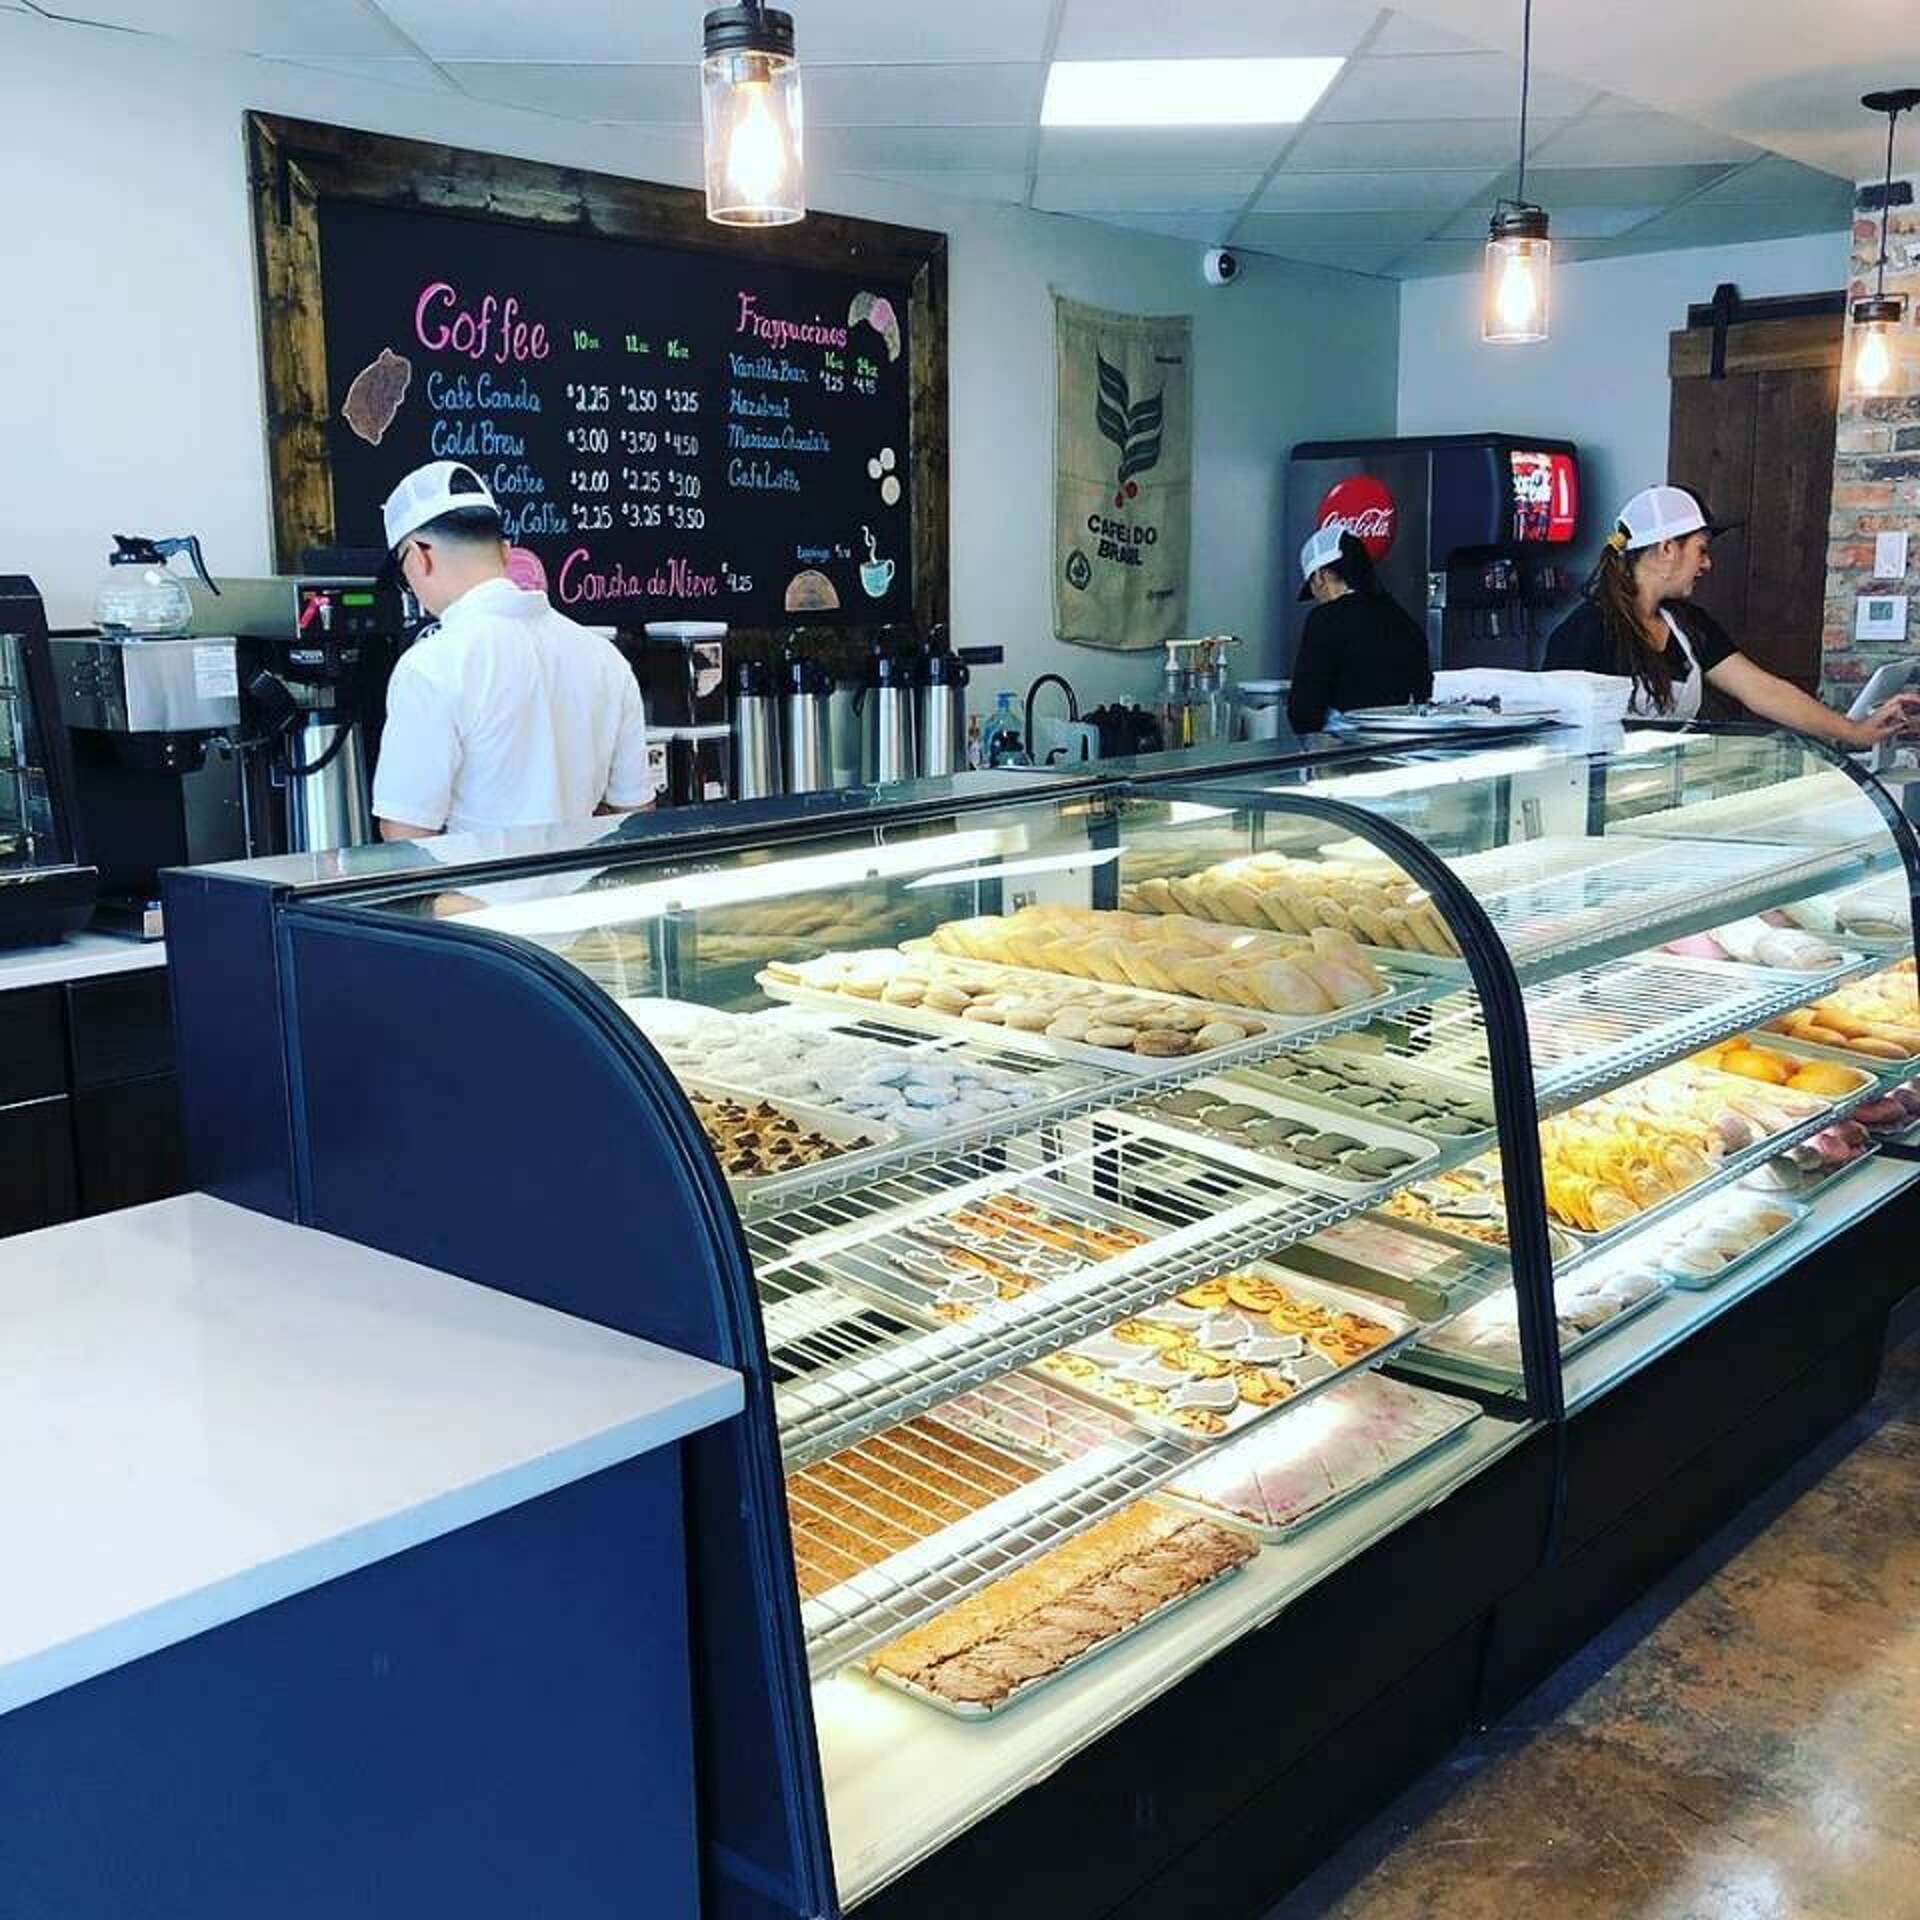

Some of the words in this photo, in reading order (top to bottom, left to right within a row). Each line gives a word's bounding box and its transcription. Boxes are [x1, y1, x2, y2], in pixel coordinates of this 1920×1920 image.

[415, 282, 549, 363] Coffee
[729, 352, 778, 381] Vanilla
[427, 371, 476, 410] Cafe
[477, 372, 541, 413] Canela
[566, 383, 609, 412] $2.25
[431, 419, 479, 457] Cold
[480, 419, 525, 457] Brew
[567, 427, 609, 454] $3.00
[621, 429, 657, 455] $3.50
[494, 463, 544, 494] Coffee
[570, 468, 609, 493] $2.00
[622, 466, 661, 494] $2.25
[668, 468, 701, 499] $3.00
[521, 501, 568, 534] Coffee
[571, 502, 613, 531] $2.25
[621, 502, 661, 528] $3.25
[667, 504, 705, 530] $3.50
[1133, 526, 1158, 546] DO
[559, 548, 642, 603] Concha
[647, 567, 666, 597] de
[667, 557, 718, 598] Nieve
